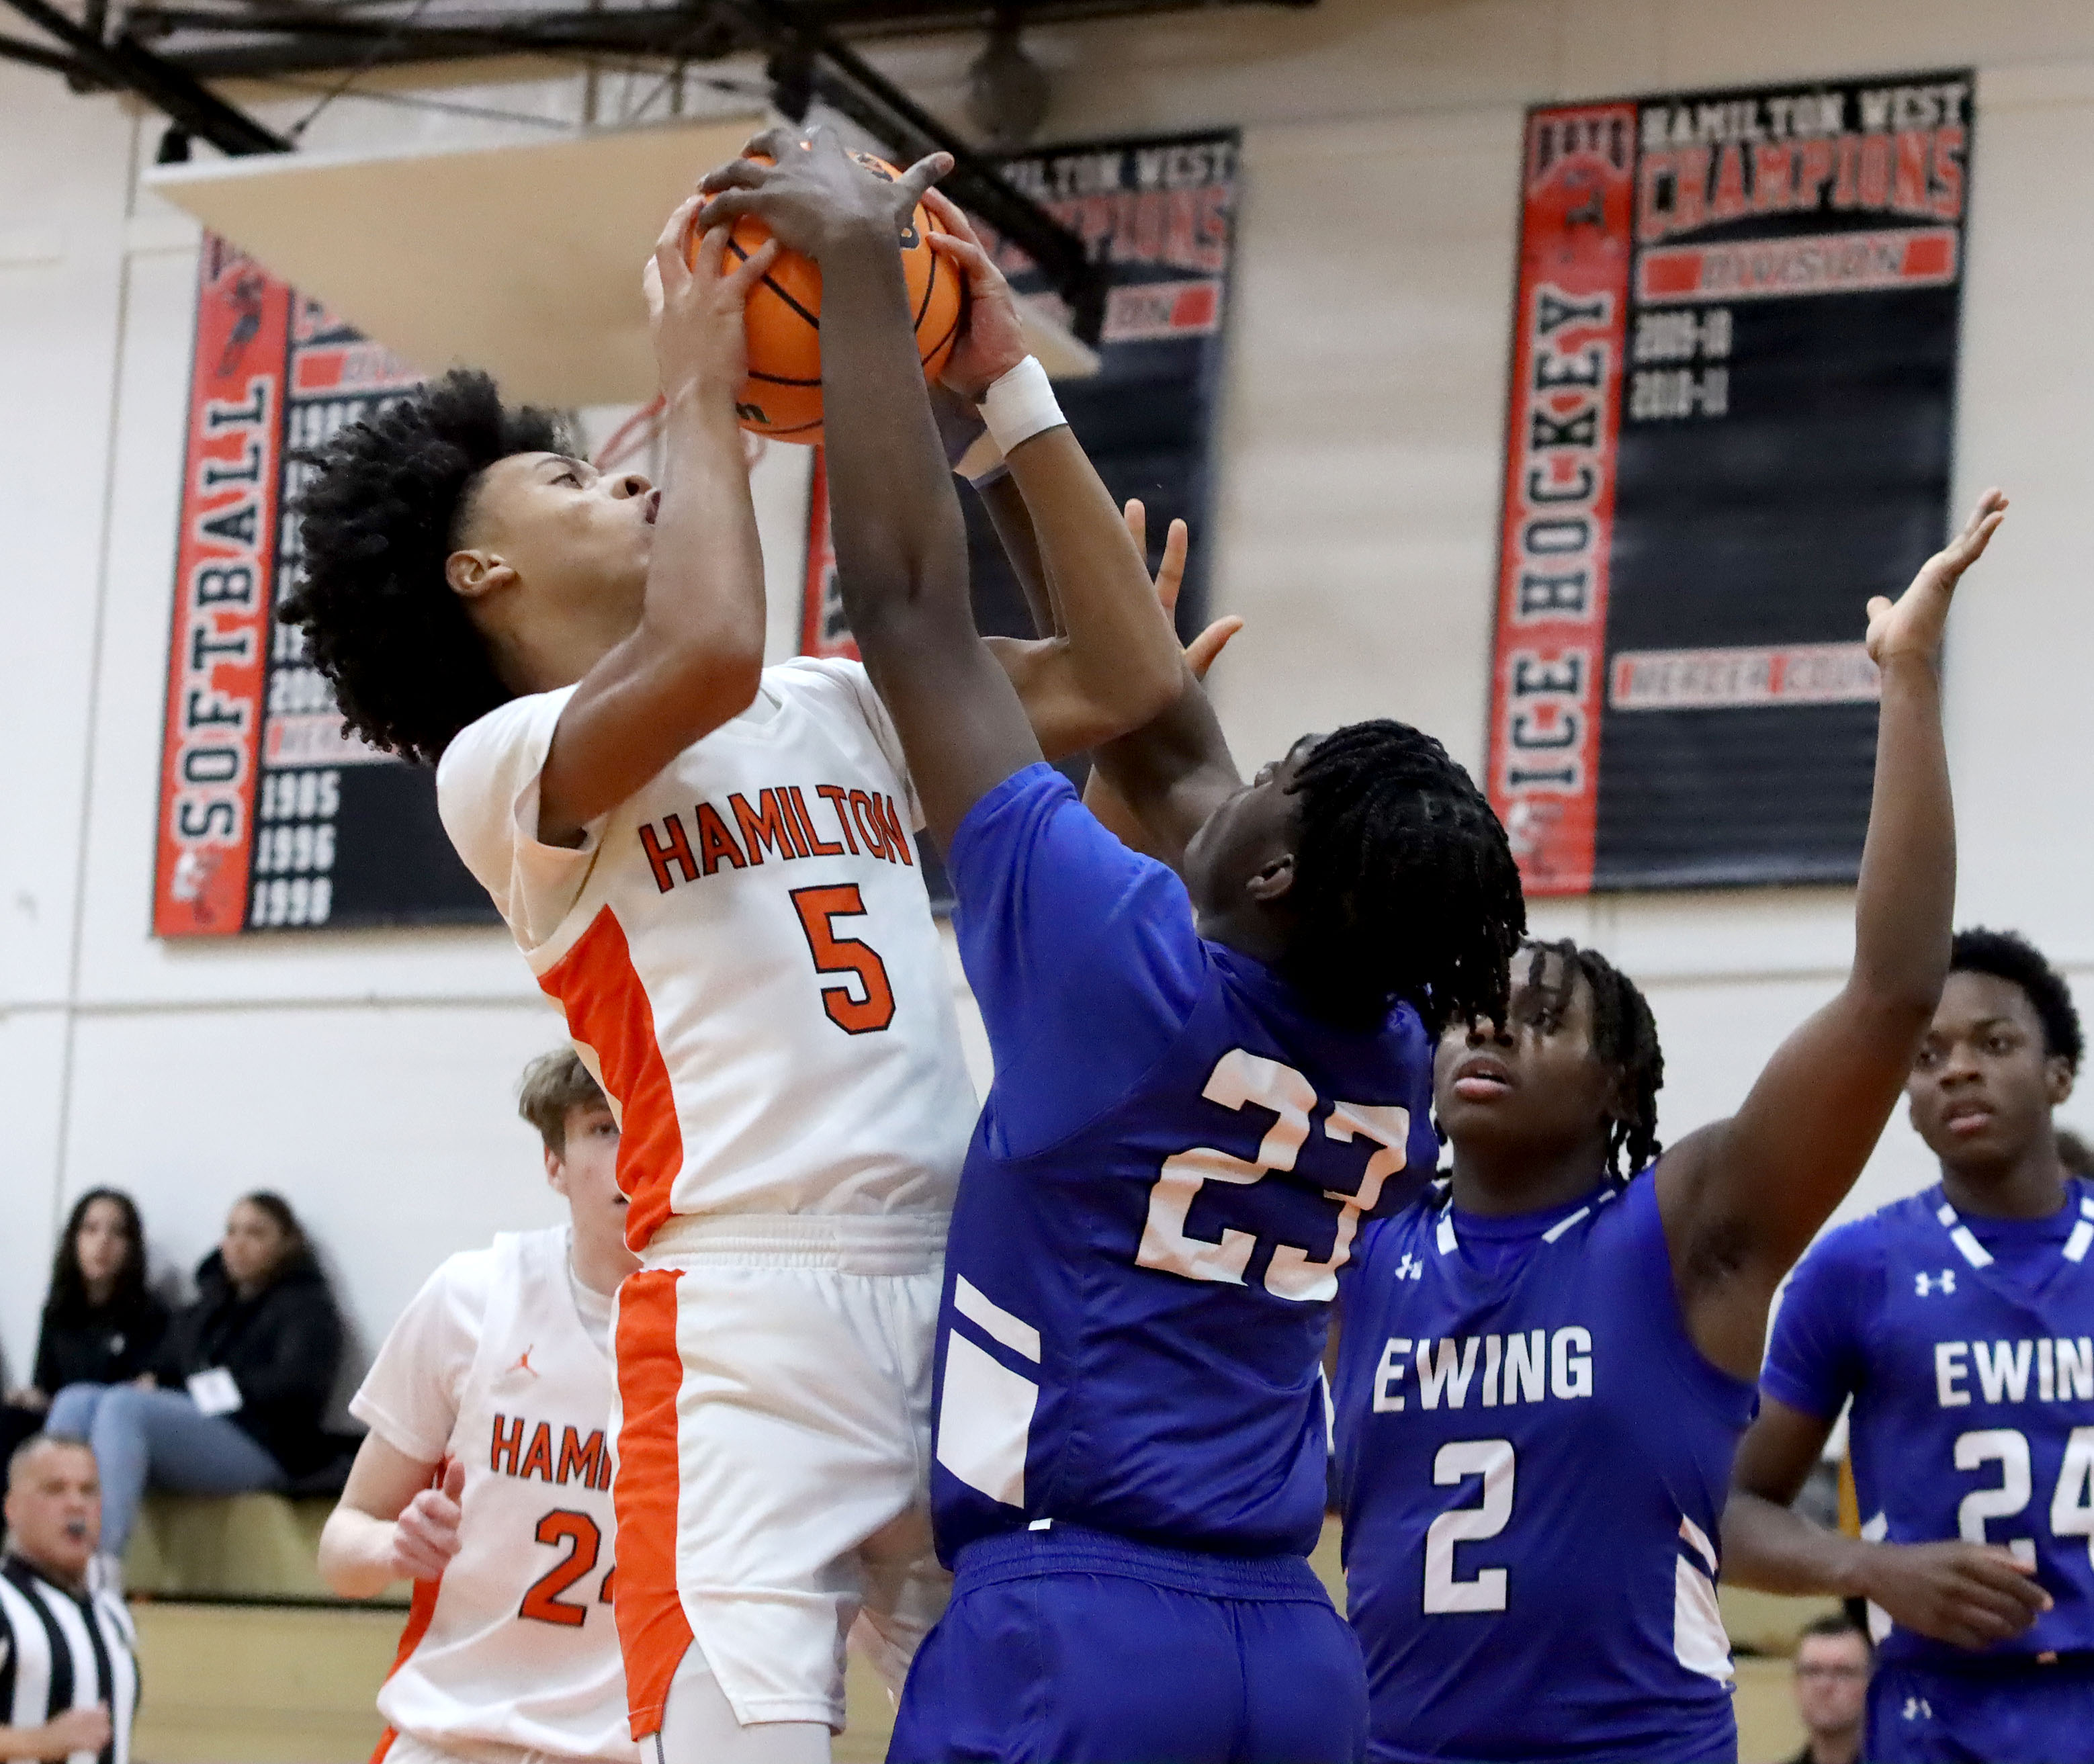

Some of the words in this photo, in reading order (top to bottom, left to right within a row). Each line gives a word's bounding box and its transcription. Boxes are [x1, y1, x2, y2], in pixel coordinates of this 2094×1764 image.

[1137, 142, 1235, 189] WEST
[1639, 91, 1844, 146] HAMILTON
[1860, 83, 1968, 129] WEST
[1638, 128, 1964, 239] CHAMPIONS
[1702, 243, 1903, 290] DIVISION
[1518, 288, 1610, 620] HOCKEY
[173, 376, 272, 845] SOFTBALL
[1507, 653, 1584, 793] ICE
[638, 783, 914, 894] HAMILTON
[787, 883, 897, 1036] 5
[1134, 1048, 1410, 1302] 23
[1372, 1325, 1594, 1413] EWING
[1935, 1337, 2094, 1408] EWIN
[490, 1413, 612, 1492] HAMI
[1423, 1438, 1516, 1615] 2
